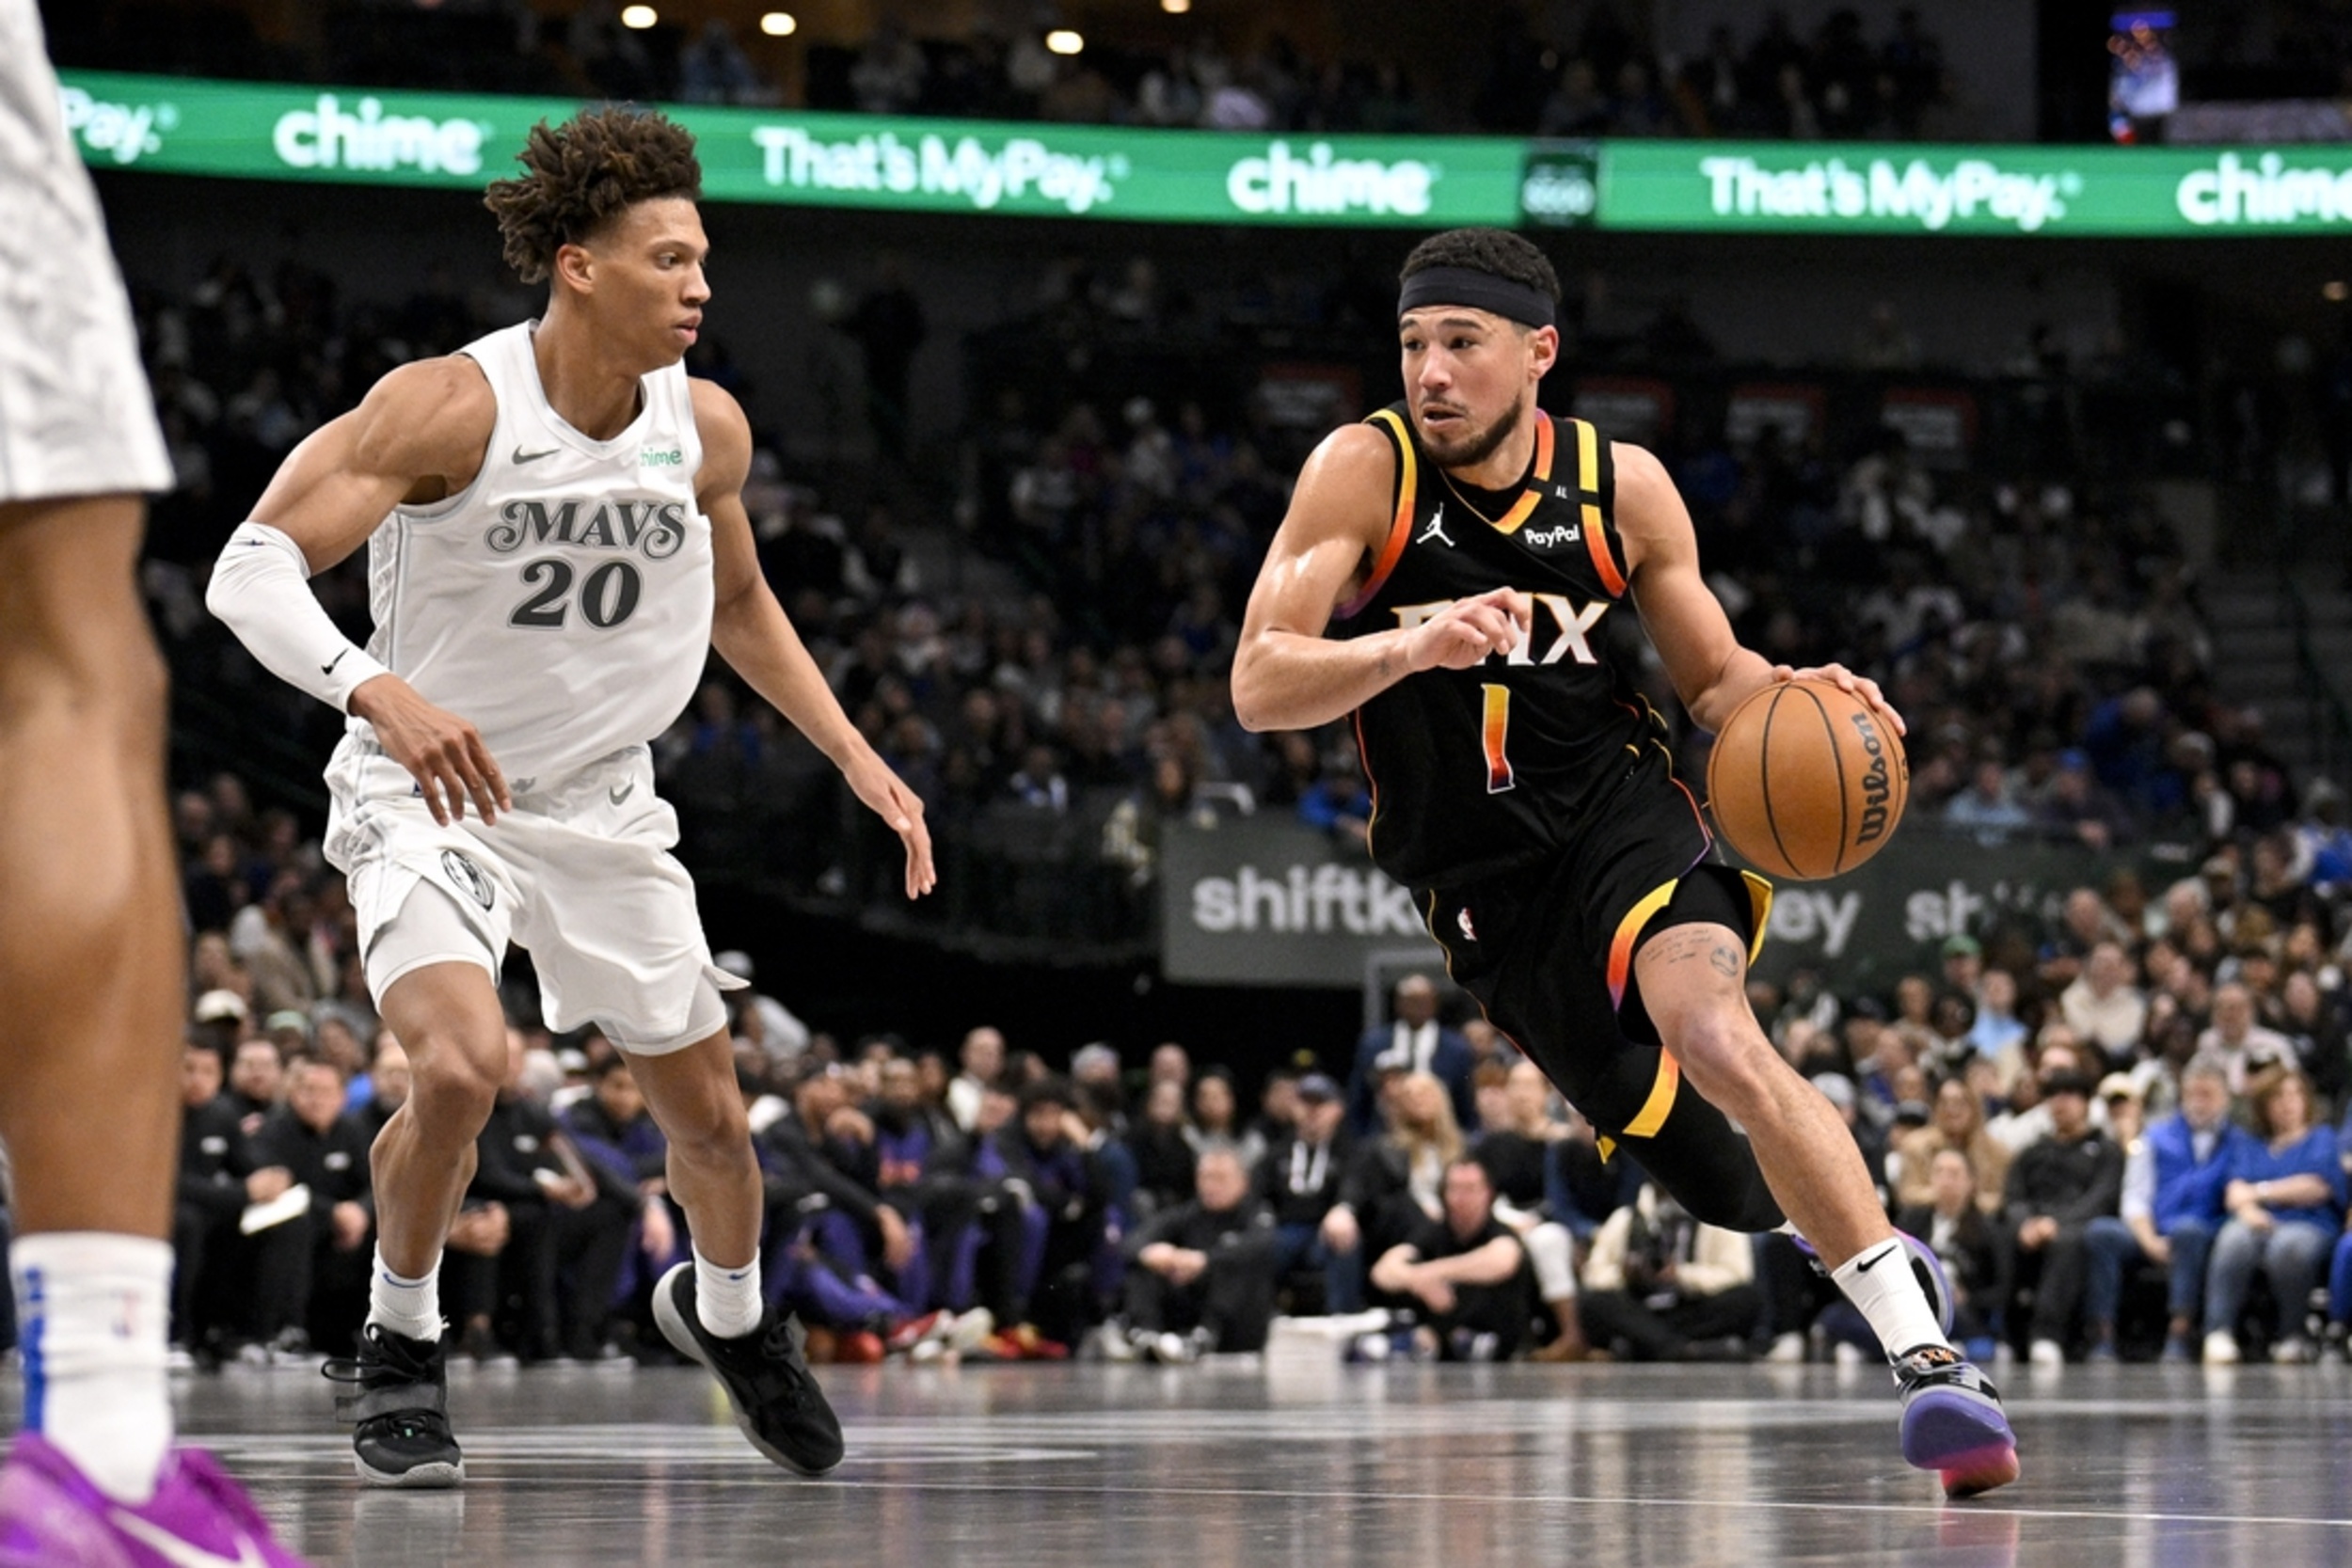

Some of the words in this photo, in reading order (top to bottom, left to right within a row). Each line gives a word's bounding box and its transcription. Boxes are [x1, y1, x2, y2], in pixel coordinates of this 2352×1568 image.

[274, 94, 483, 175] chime
[1227, 140, 1432, 215] chime
[485, 499, 687, 561] MAVS
[1524, 523, 1581, 548] PayPal
[508, 557, 644, 629] 20
[1480, 682, 1516, 794] 1
[1851, 712, 1890, 846] Wilson
[1192, 863, 1428, 935] shiftk
